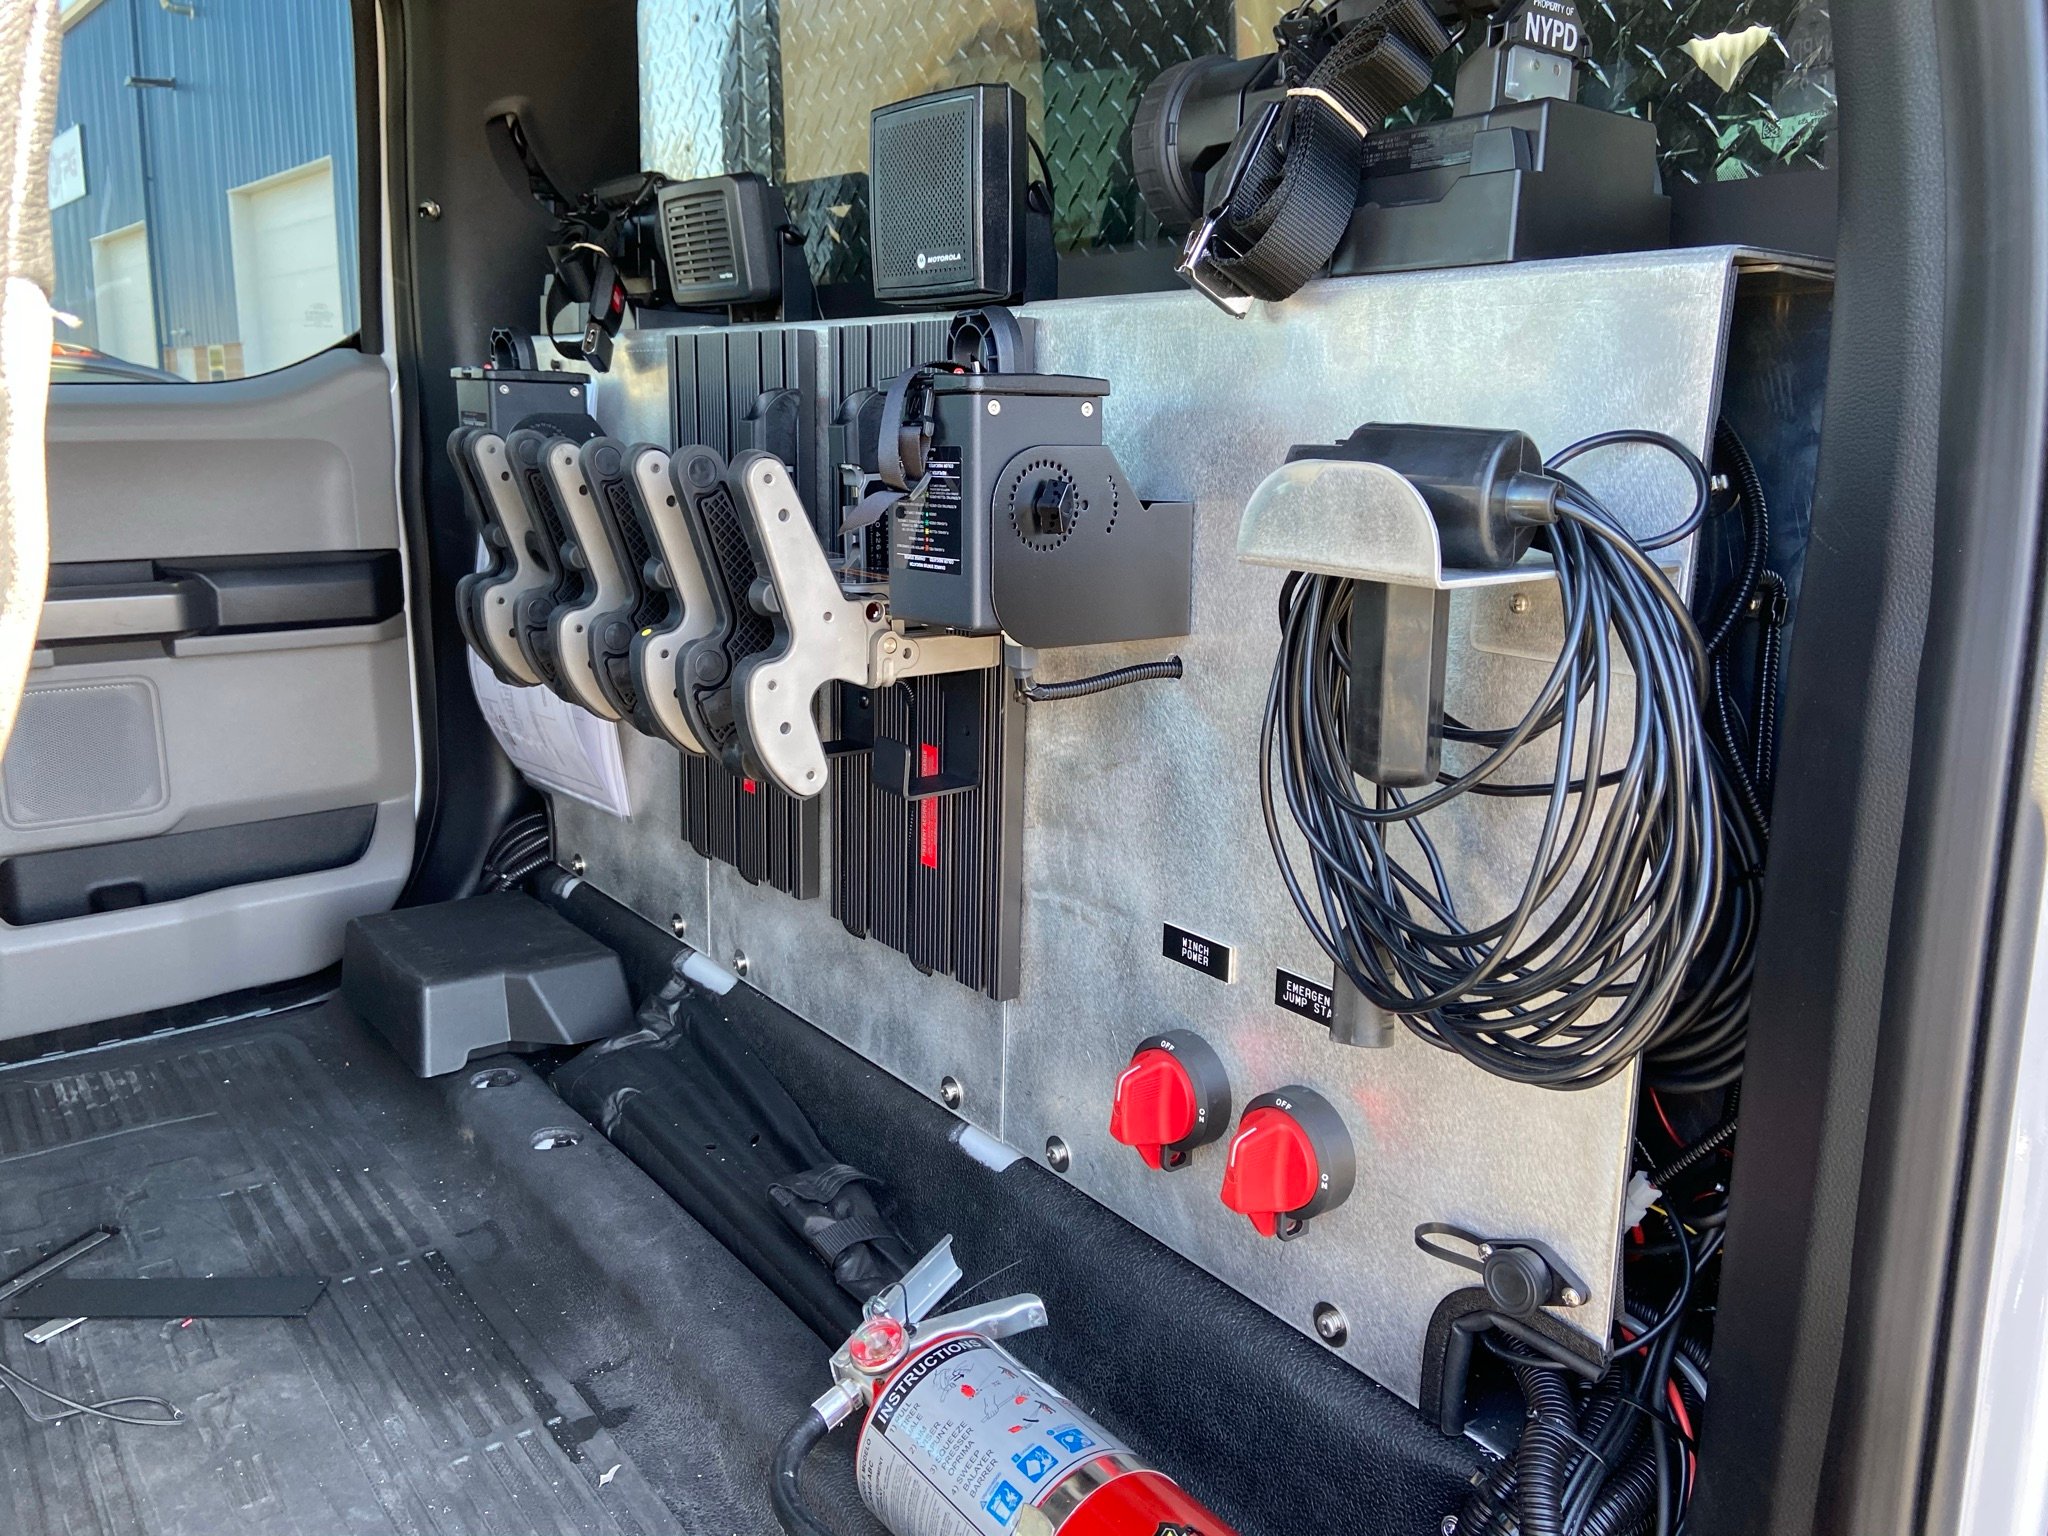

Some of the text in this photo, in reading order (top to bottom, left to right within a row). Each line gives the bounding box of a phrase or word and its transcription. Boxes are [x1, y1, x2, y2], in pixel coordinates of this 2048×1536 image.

[1533, 0, 1575, 16] PROPERTY OF
[1525, 11, 1578, 52] NYPD
[927, 253, 961, 264] MOTOROLA
[1181, 948, 1209, 967] POWER
[1182, 936, 1210, 956] WINCH
[1282, 992, 1332, 1019] JUMP STA
[1286, 980, 1331, 1006] EMERGEN
[1160, 1040, 1175, 1051] OFF
[1198, 1108, 1206, 1123] ON
[1275, 1098, 1293, 1111] OFF
[1320, 1174, 1329, 1190] ON
[877, 1339, 984, 1425] INSTRUCTIONS
[890, 1402, 912, 1433] 1) PULL
[900, 1402, 921, 1430] TIRER
[920, 1421, 942, 1448] VISER
[927, 1420, 954, 1458] APUNTE
[930, 1420, 968, 1474] 3) SQUEEZE
[908, 1444, 917, 1454] 2)
[942, 1427, 974, 1470] PRESSER
[948, 1440, 975, 1476] OPRIMA
[951, 1449, 980, 1496] 4) SWEEP
[962, 1449, 994, 1492] BALAYER
[970, 1458, 998, 1498] BARRER
